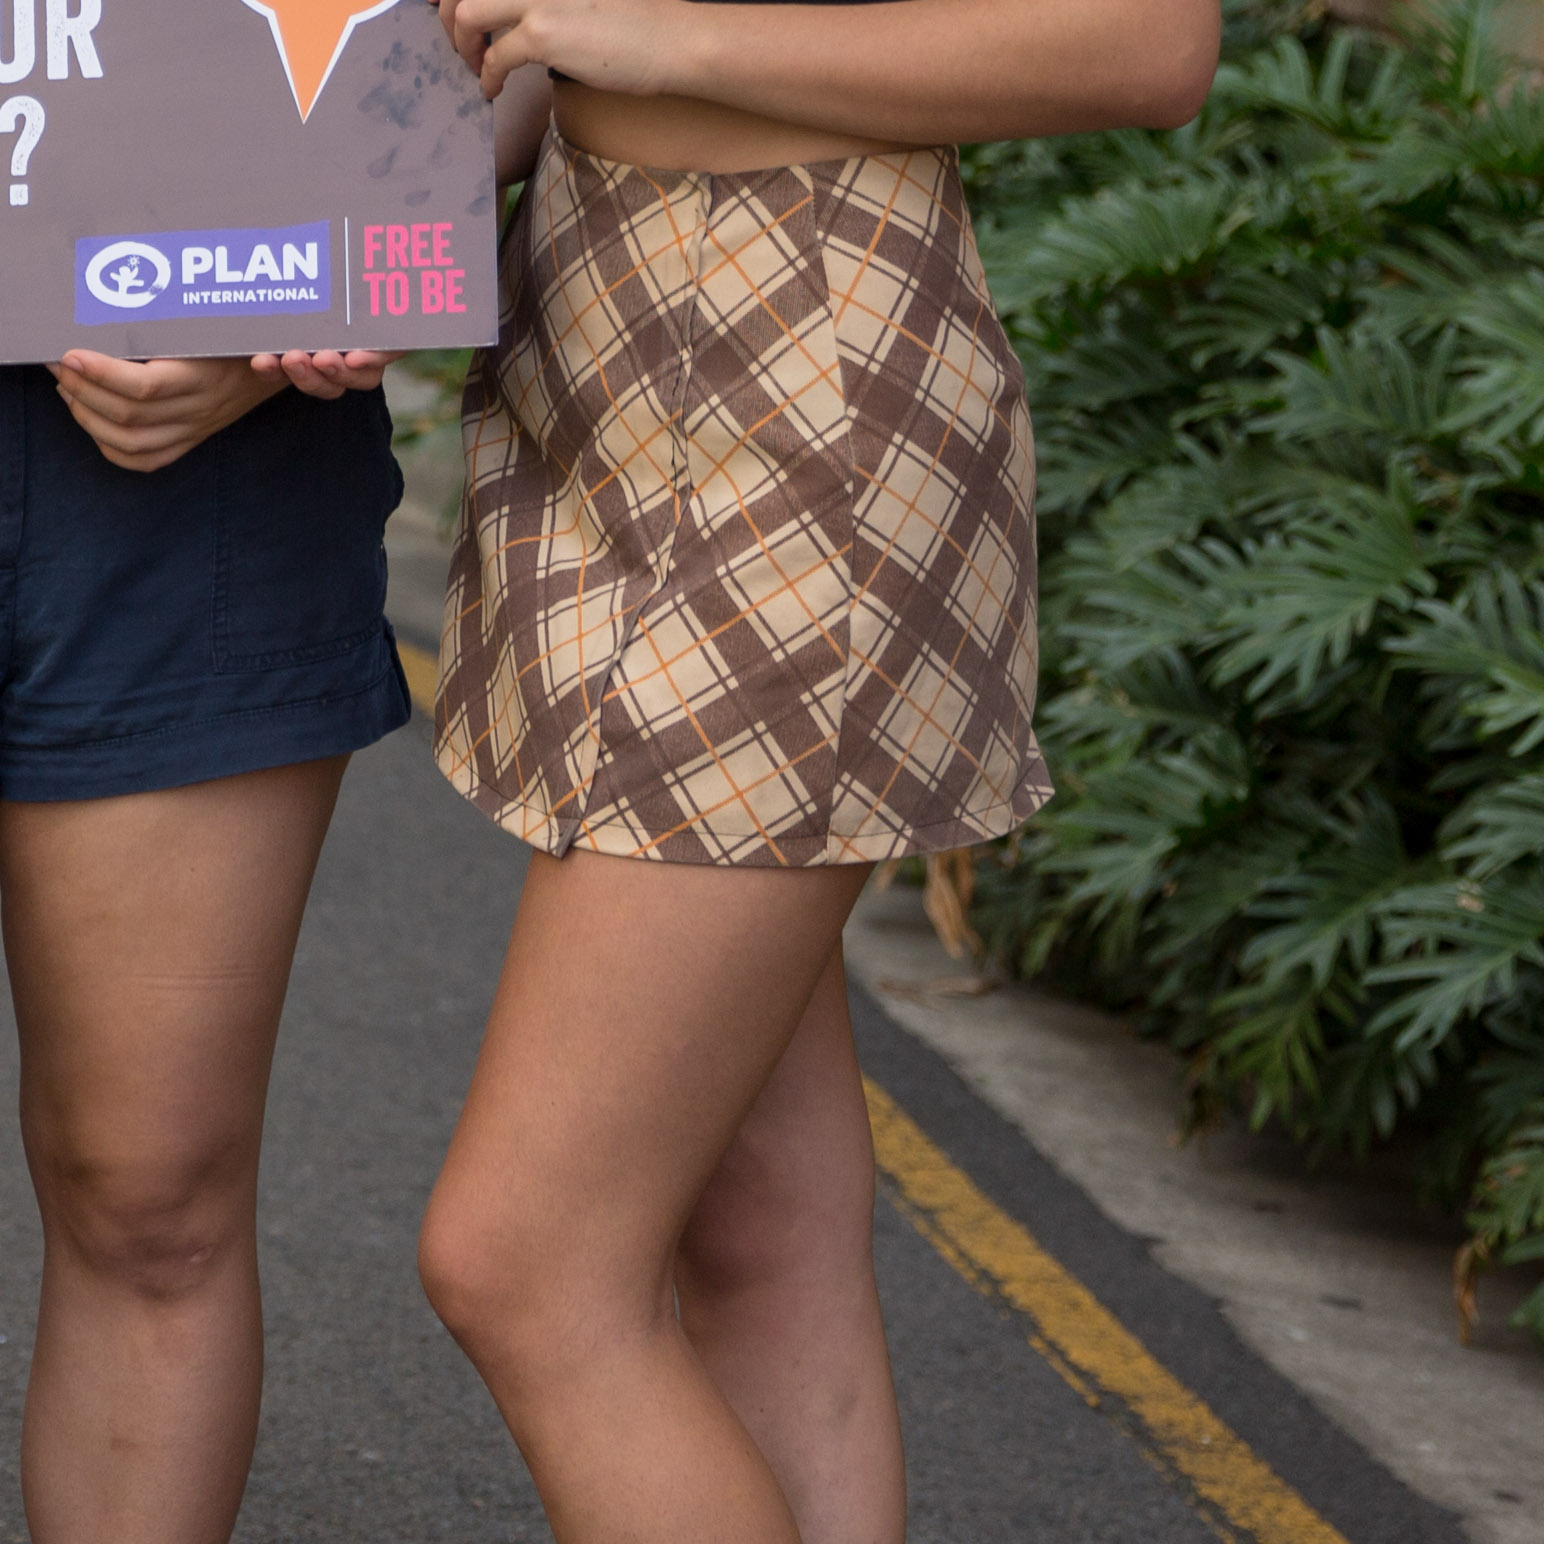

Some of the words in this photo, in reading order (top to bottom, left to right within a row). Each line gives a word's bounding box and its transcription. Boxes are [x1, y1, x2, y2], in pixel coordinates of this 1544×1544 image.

[182, 242, 318, 284] PLAN
[364, 222, 454, 268] FREE
[183, 288, 318, 304] INTERNATIONAL
[363, 271, 409, 316] TO
[421, 269, 466, 314] BE
